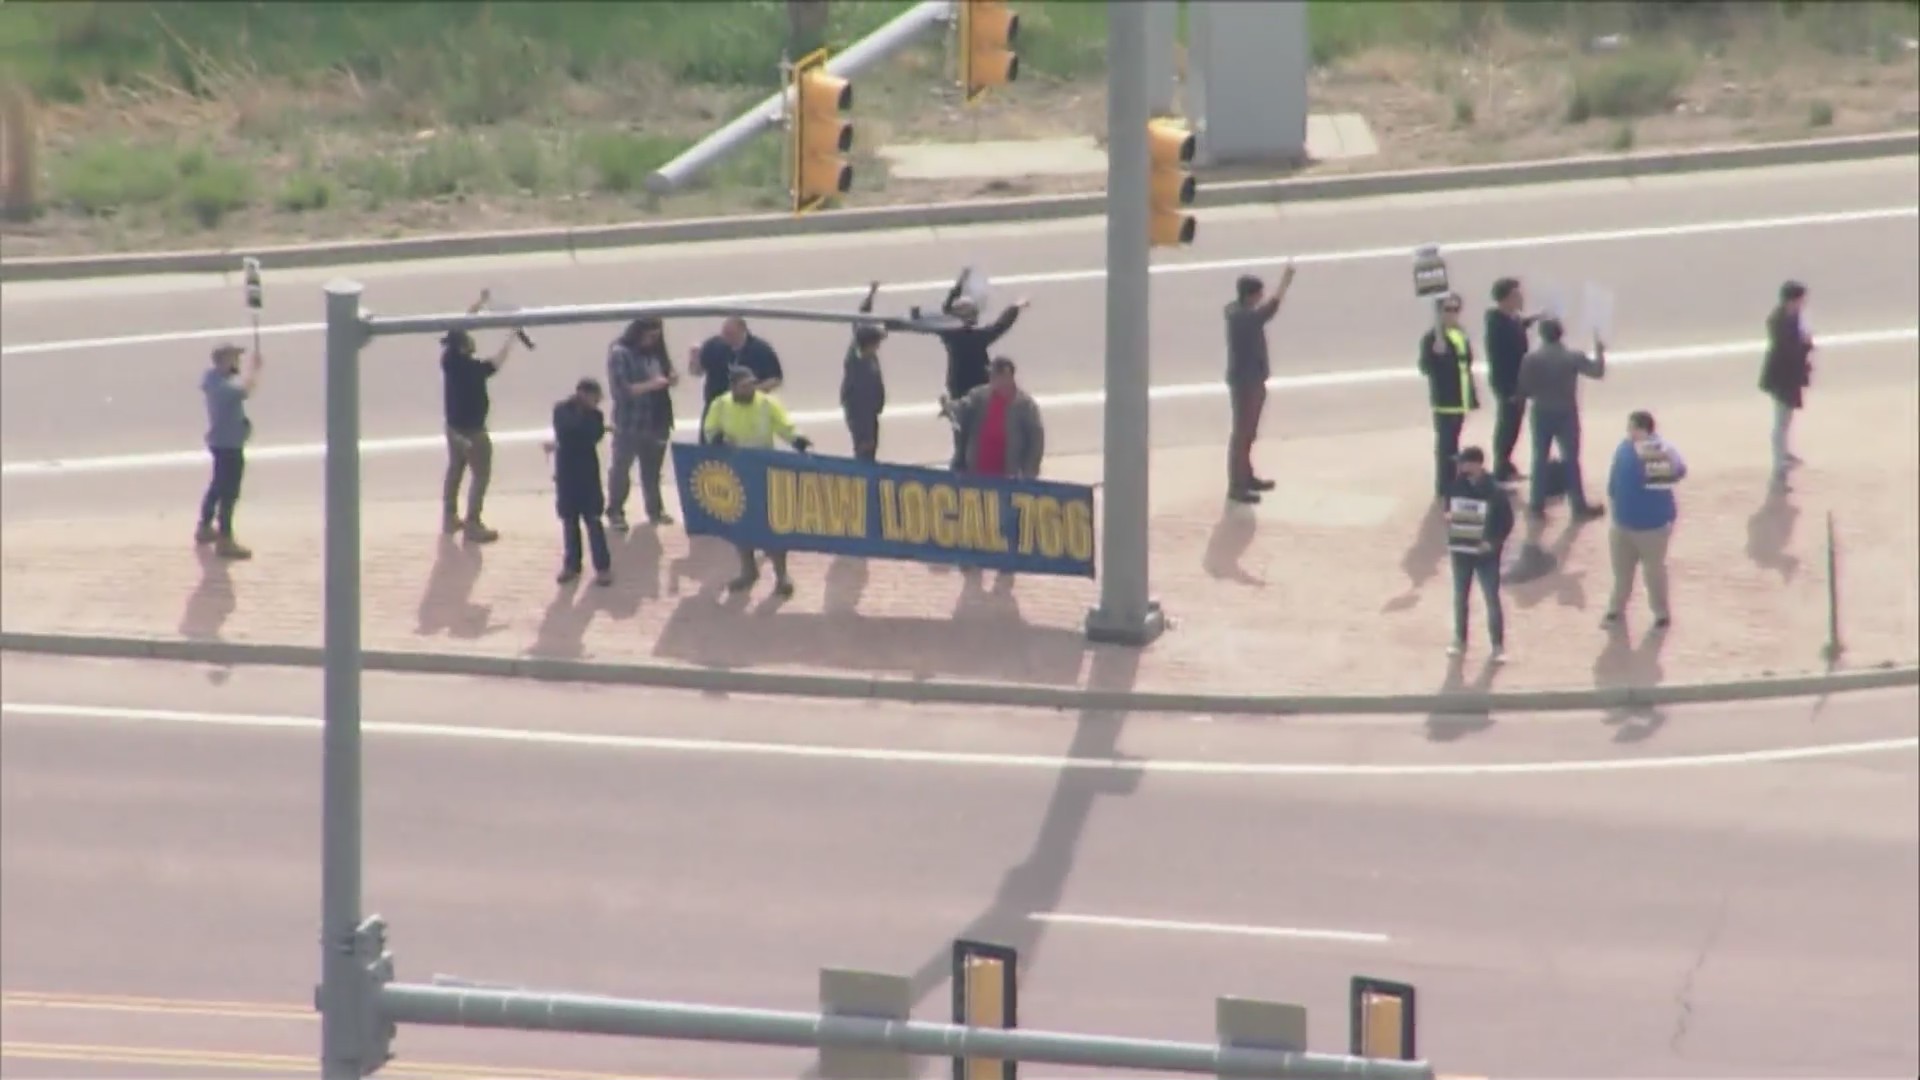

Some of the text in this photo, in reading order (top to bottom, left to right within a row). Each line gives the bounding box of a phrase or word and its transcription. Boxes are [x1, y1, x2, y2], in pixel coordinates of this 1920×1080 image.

[766, 466, 1092, 561] UAW LOCAL 766
